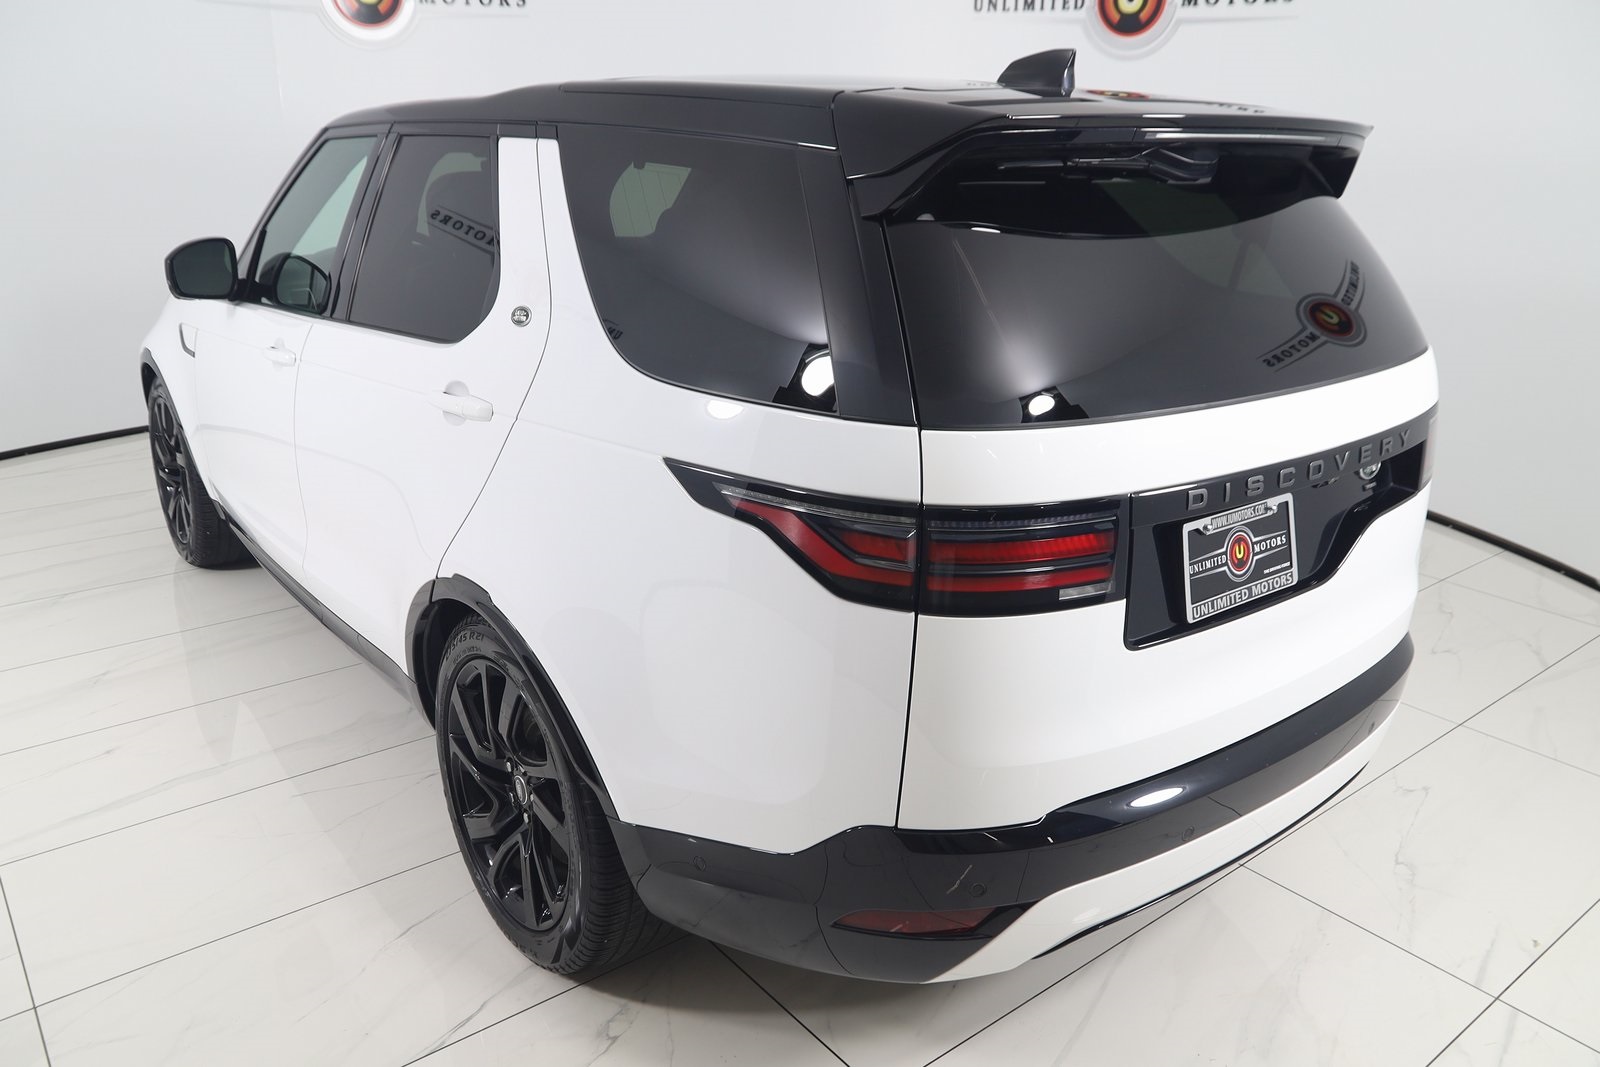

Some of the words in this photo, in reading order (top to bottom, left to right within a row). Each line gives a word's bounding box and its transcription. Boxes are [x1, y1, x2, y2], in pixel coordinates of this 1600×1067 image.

[1187, 429, 1411, 512] DISCOVERY
[1189, 555, 1227, 574] UNLIMITED
[1254, 535, 1287, 553] MOTORS
[1193, 590, 1249, 619] UNLIMITED
[1251, 572, 1293, 597] MOTORS
